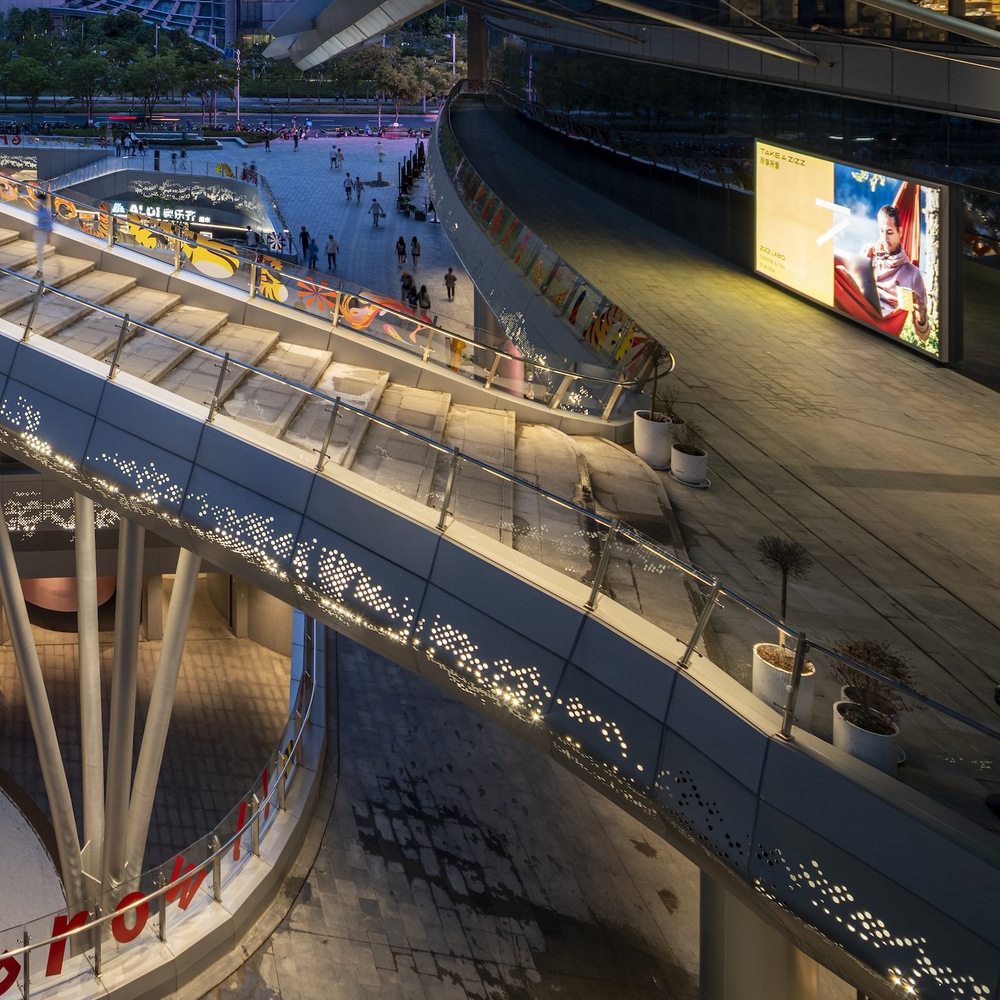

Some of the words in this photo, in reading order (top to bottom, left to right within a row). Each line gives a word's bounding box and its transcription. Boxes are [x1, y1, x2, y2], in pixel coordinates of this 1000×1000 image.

[760, 148, 780, 159] TAKE
[129, 203, 161, 217] ALDI
[163, 208, 196, 222] 奥乐齐
